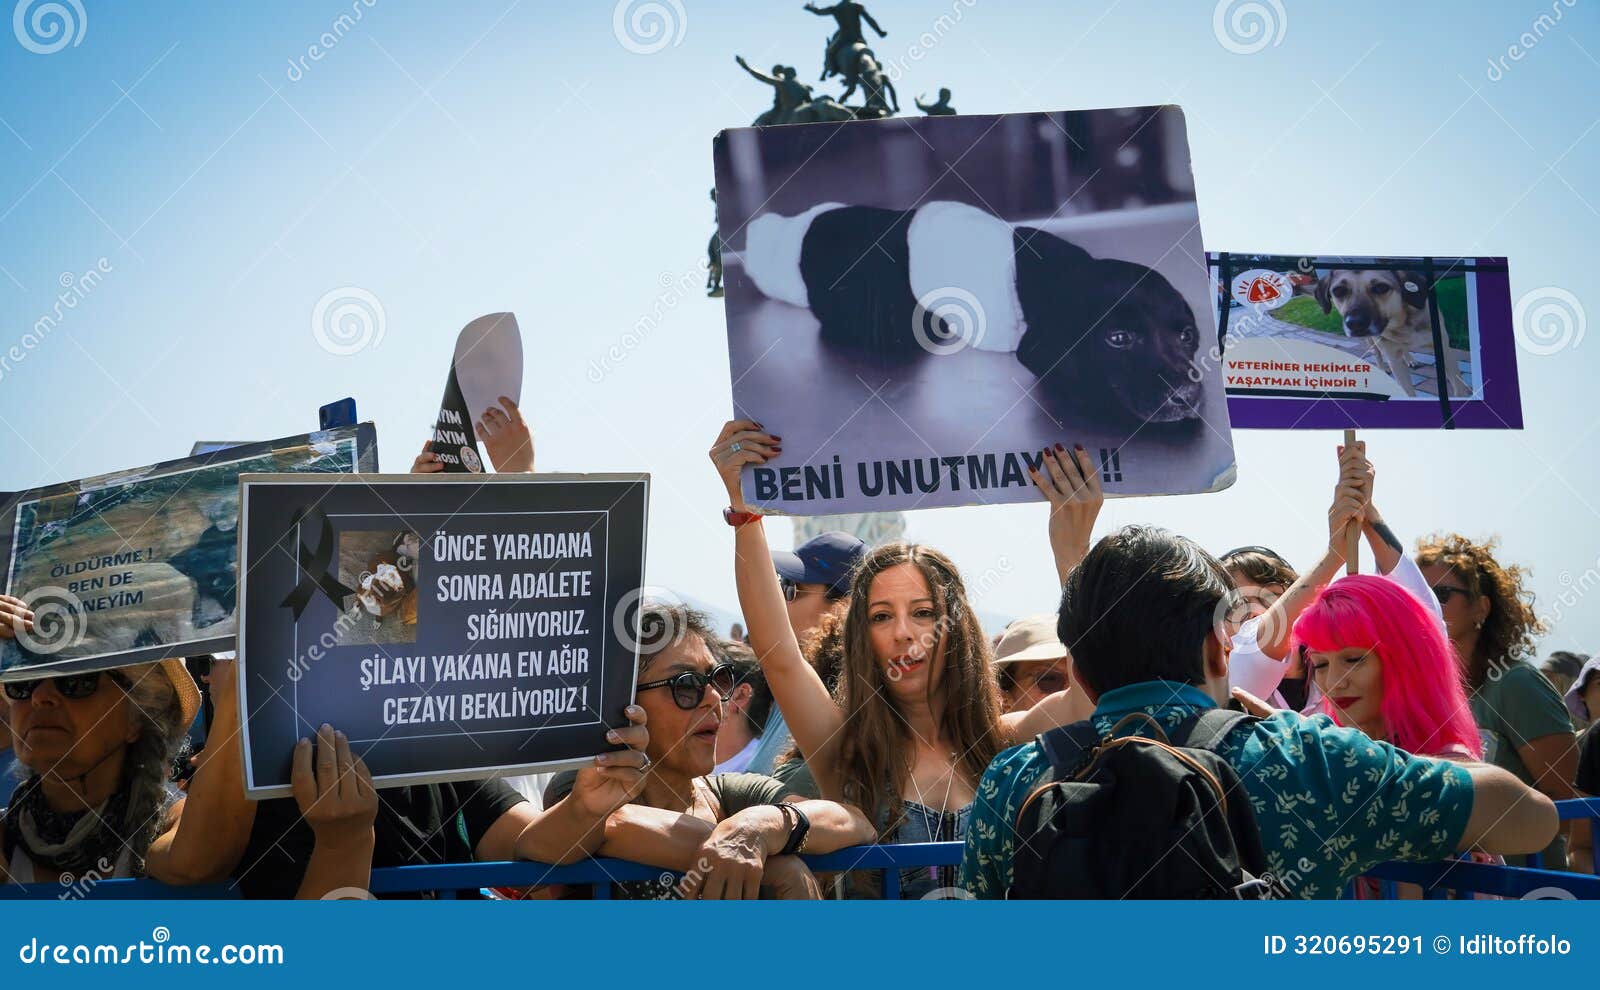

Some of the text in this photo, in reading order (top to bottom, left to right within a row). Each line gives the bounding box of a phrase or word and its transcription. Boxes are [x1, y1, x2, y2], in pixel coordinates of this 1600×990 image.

[1228, 360, 1371, 373] VETERİNER HEKİMLER
[1227, 376, 1301, 388] YAŞATMAK
[1305, 376, 1357, 389] İÇİNDİR
[432, 429, 468, 446] AYIM
[753, 455, 844, 501] BENİ
[857, 450, 1088, 498] UNUTMAY
[433, 531, 592, 562] ÖNCE YARADANA
[51, 550, 142, 578] ÖLDÜRME
[68, 571, 133, 594] BEN DE
[437, 571, 592, 602] SONRA ADALETE
[66, 590, 144, 615] NNEYİM
[467, 608, 590, 641] SIĞINIYORUZ.
[360, 644, 589, 691] ŞİLAYI YAKANA EN AĞIR
[384, 695, 455, 725] CEZAYI
[461, 686, 578, 720] BEKLİYORUZ
